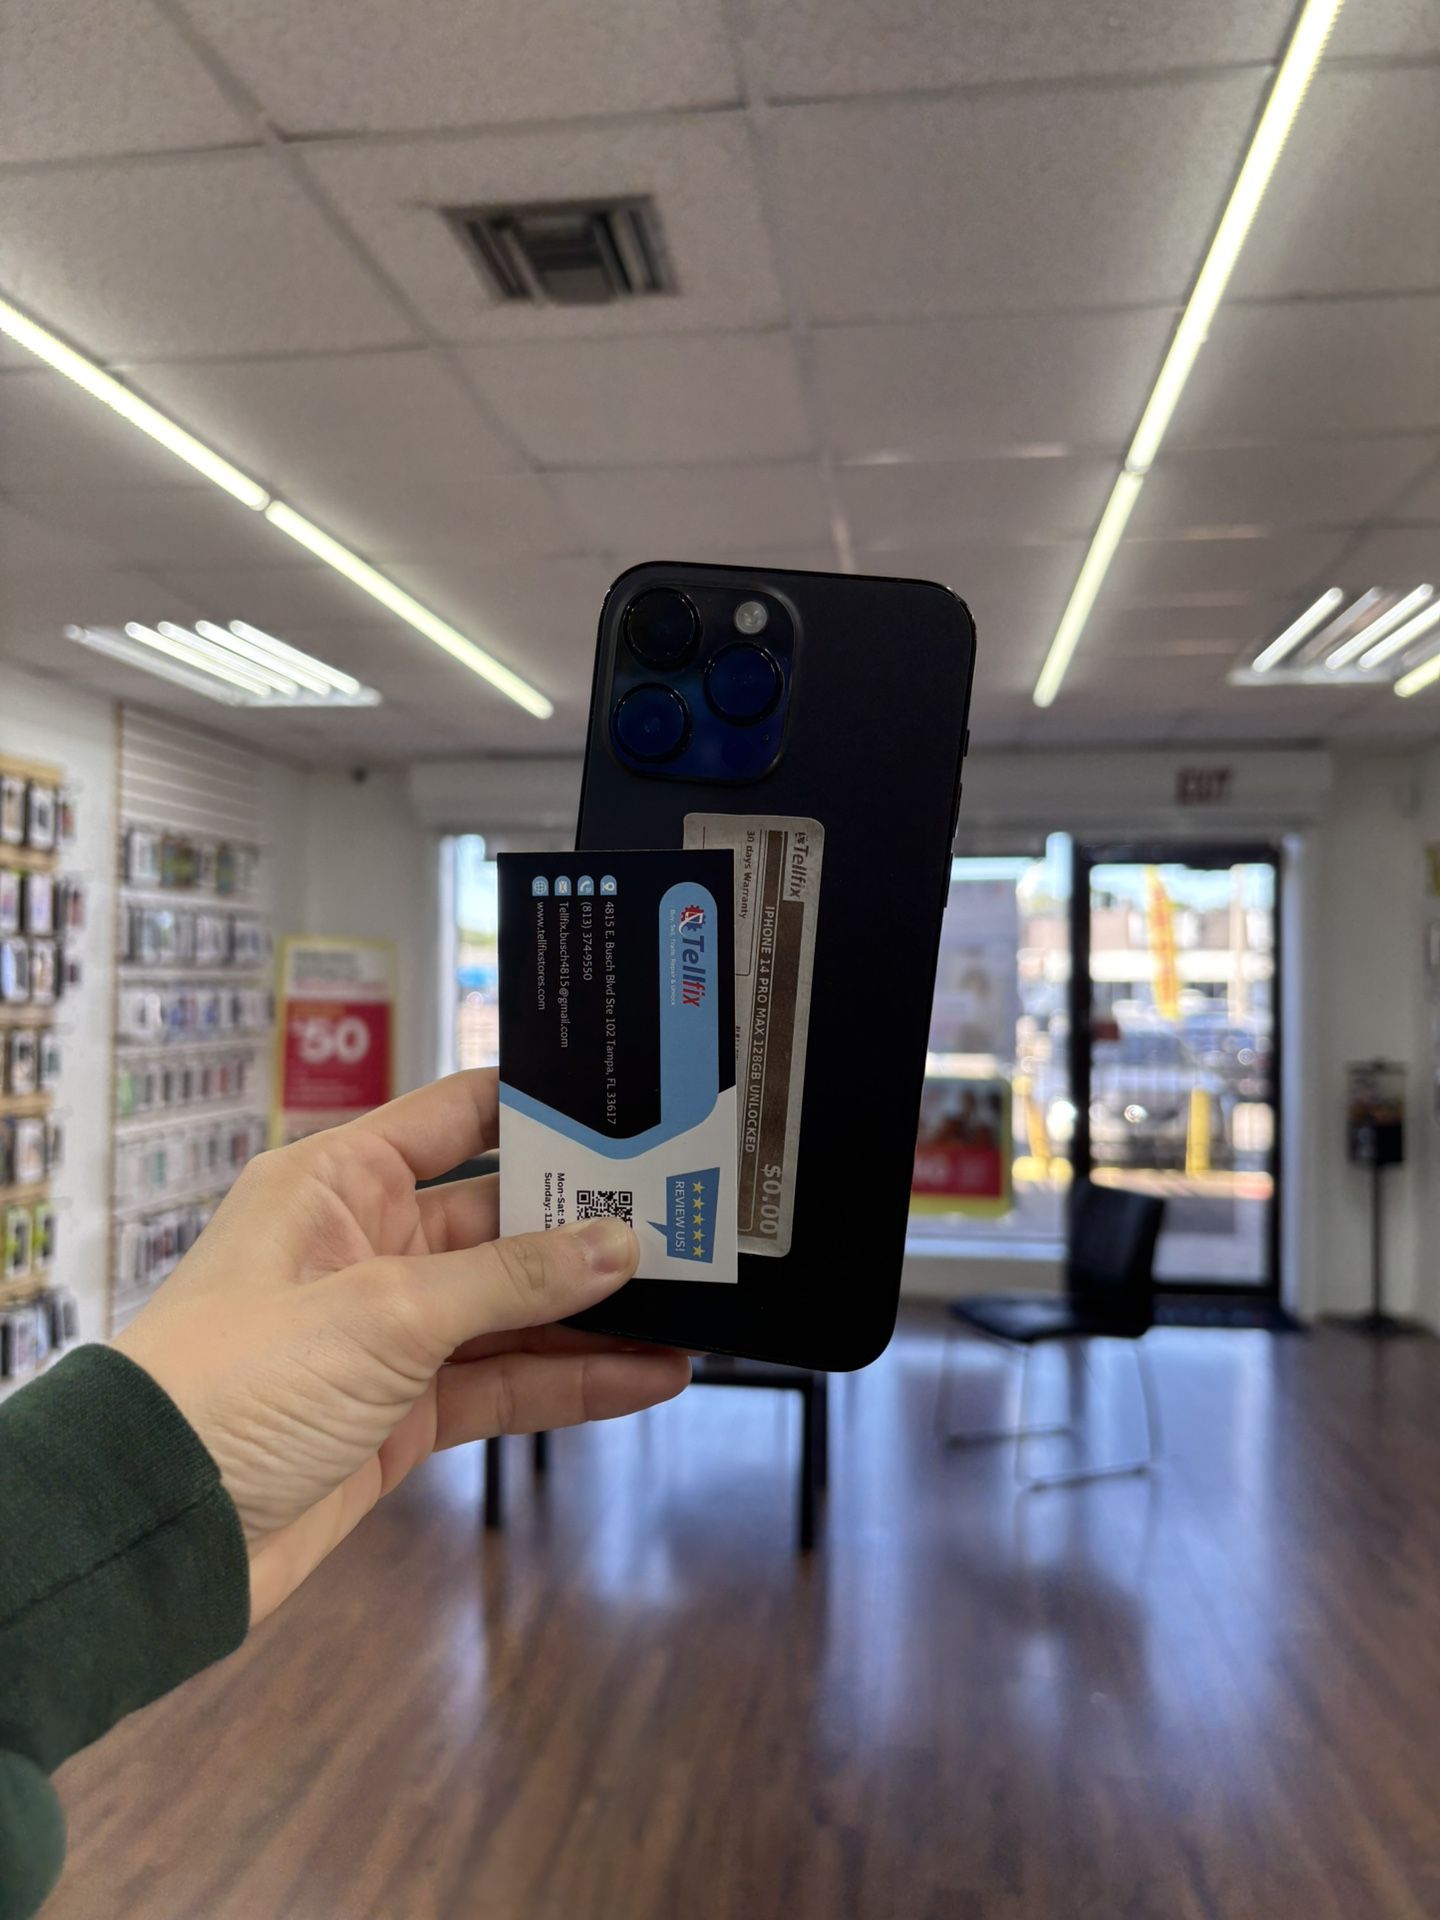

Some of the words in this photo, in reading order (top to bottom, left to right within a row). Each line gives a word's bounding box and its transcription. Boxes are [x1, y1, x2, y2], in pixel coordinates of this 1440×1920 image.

[747, 830, 755, 842] 30
[744, 845, 754, 870] days
[790, 845, 809, 898] Tellfix
[739, 872, 753, 919] Warranty
[581, 902, 593, 930] (813)
[604, 901, 615, 927] 4815
[761, 906, 775, 954] IPHONE
[605, 930, 615, 939] E.
[536, 902, 548, 1010] www.tellfixstores.com
[582, 931, 593, 981] 374-9550
[604, 942, 615, 972] Busch
[682, 935, 706, 1008] Tellfix
[759, 959, 770, 973] 14
[557, 902, 571, 1048] Tellfix.busch4815@gmail.com
[605, 973, 616, 996] Blvd
[757, 977, 769, 1004] PRO
[605, 998, 616, 1015] Ste
[754, 1007, 767, 1035] MAX
[606, 1018, 616, 1037] 102
[603, 1041, 616, 1075] Tampa,
[750, 1039, 764, 1080] 128GB
[606, 1078, 616, 1090] FL
[606, 1092, 617, 1125] 33617
[745, 1085, 761, 1153] UNLOCKED
[542, 1172, 553, 1211] Sunday:
[557, 1172, 566, 1216] Mon-Sat:
[675, 1181, 685, 1231] REVIEW
[759, 1163, 783, 1234] $0.00
[675, 1233, 686, 1252] US!
